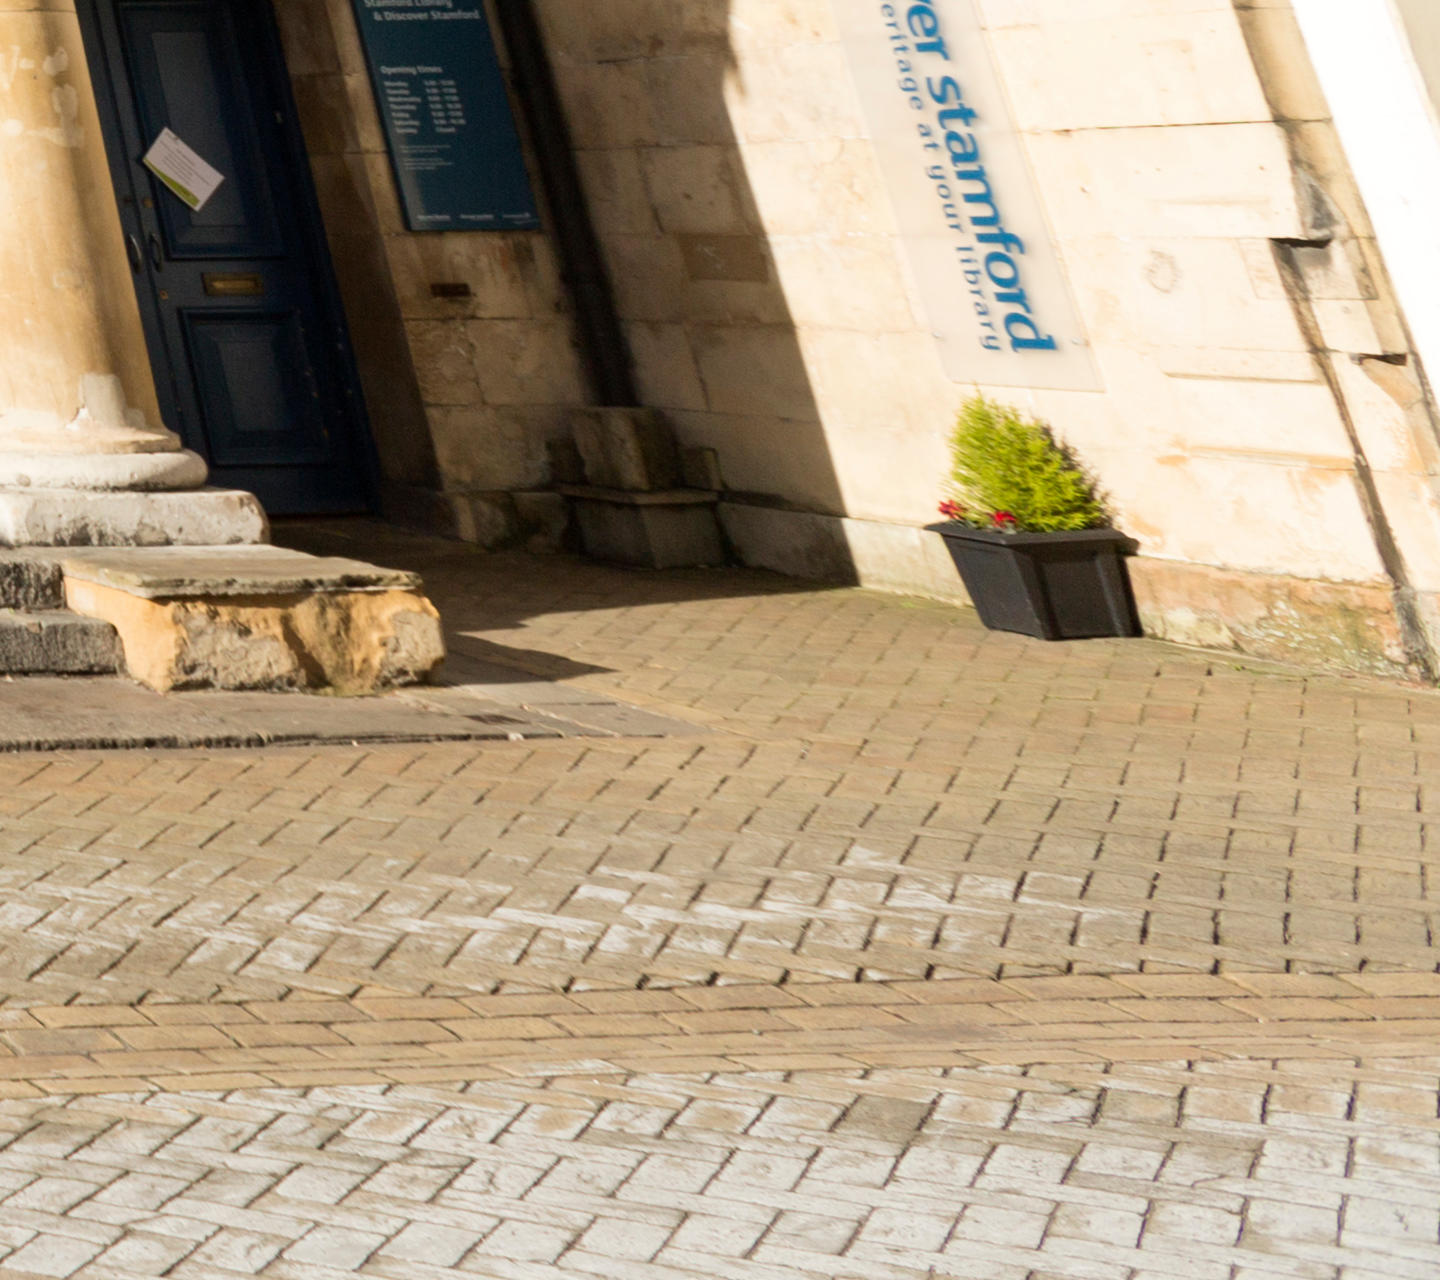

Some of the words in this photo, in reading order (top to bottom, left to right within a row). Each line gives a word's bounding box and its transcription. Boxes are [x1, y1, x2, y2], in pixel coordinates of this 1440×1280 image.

[384, 11, 428, 21] Discover
[429, 10, 480, 20] Stamford
[917, 122, 941, 152] at
[925, 165, 963, 233] your
[926, 75, 1060, 354] stamford
[955, 246, 1003, 352] library
